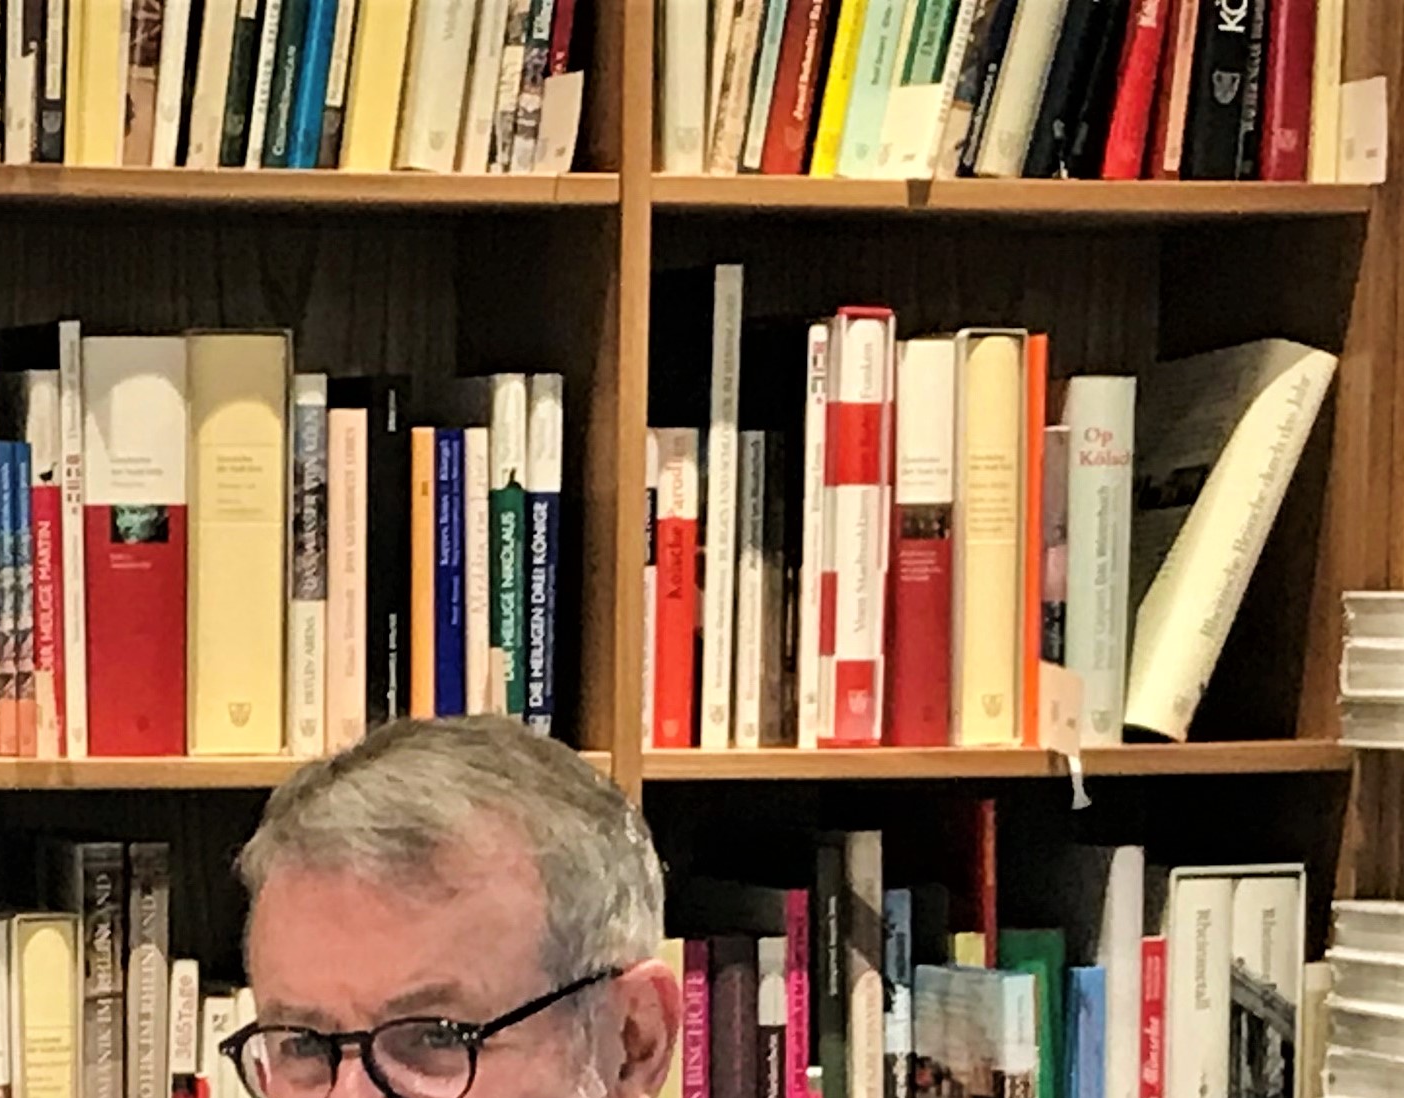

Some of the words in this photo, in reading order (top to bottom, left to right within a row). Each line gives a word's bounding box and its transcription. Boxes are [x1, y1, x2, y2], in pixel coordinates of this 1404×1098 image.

[1084, 427, 1113, 447] Op
[37, 520, 53, 580] MARTIN
[500, 511, 515, 587] NIKOLAUS
[529, 501, 547, 563] KÖNIGE
[530, 568, 545, 603] DREI
[38, 583, 54, 640] HEILIGE
[500, 591, 515, 646] HEILIGE
[40, 644, 54, 674] DER
[530, 607, 544, 677] HEILIGEN
[529, 682, 543, 706] DIE
[97, 999, 111, 1021] IM
[139, 1020, 154, 1043] IM
